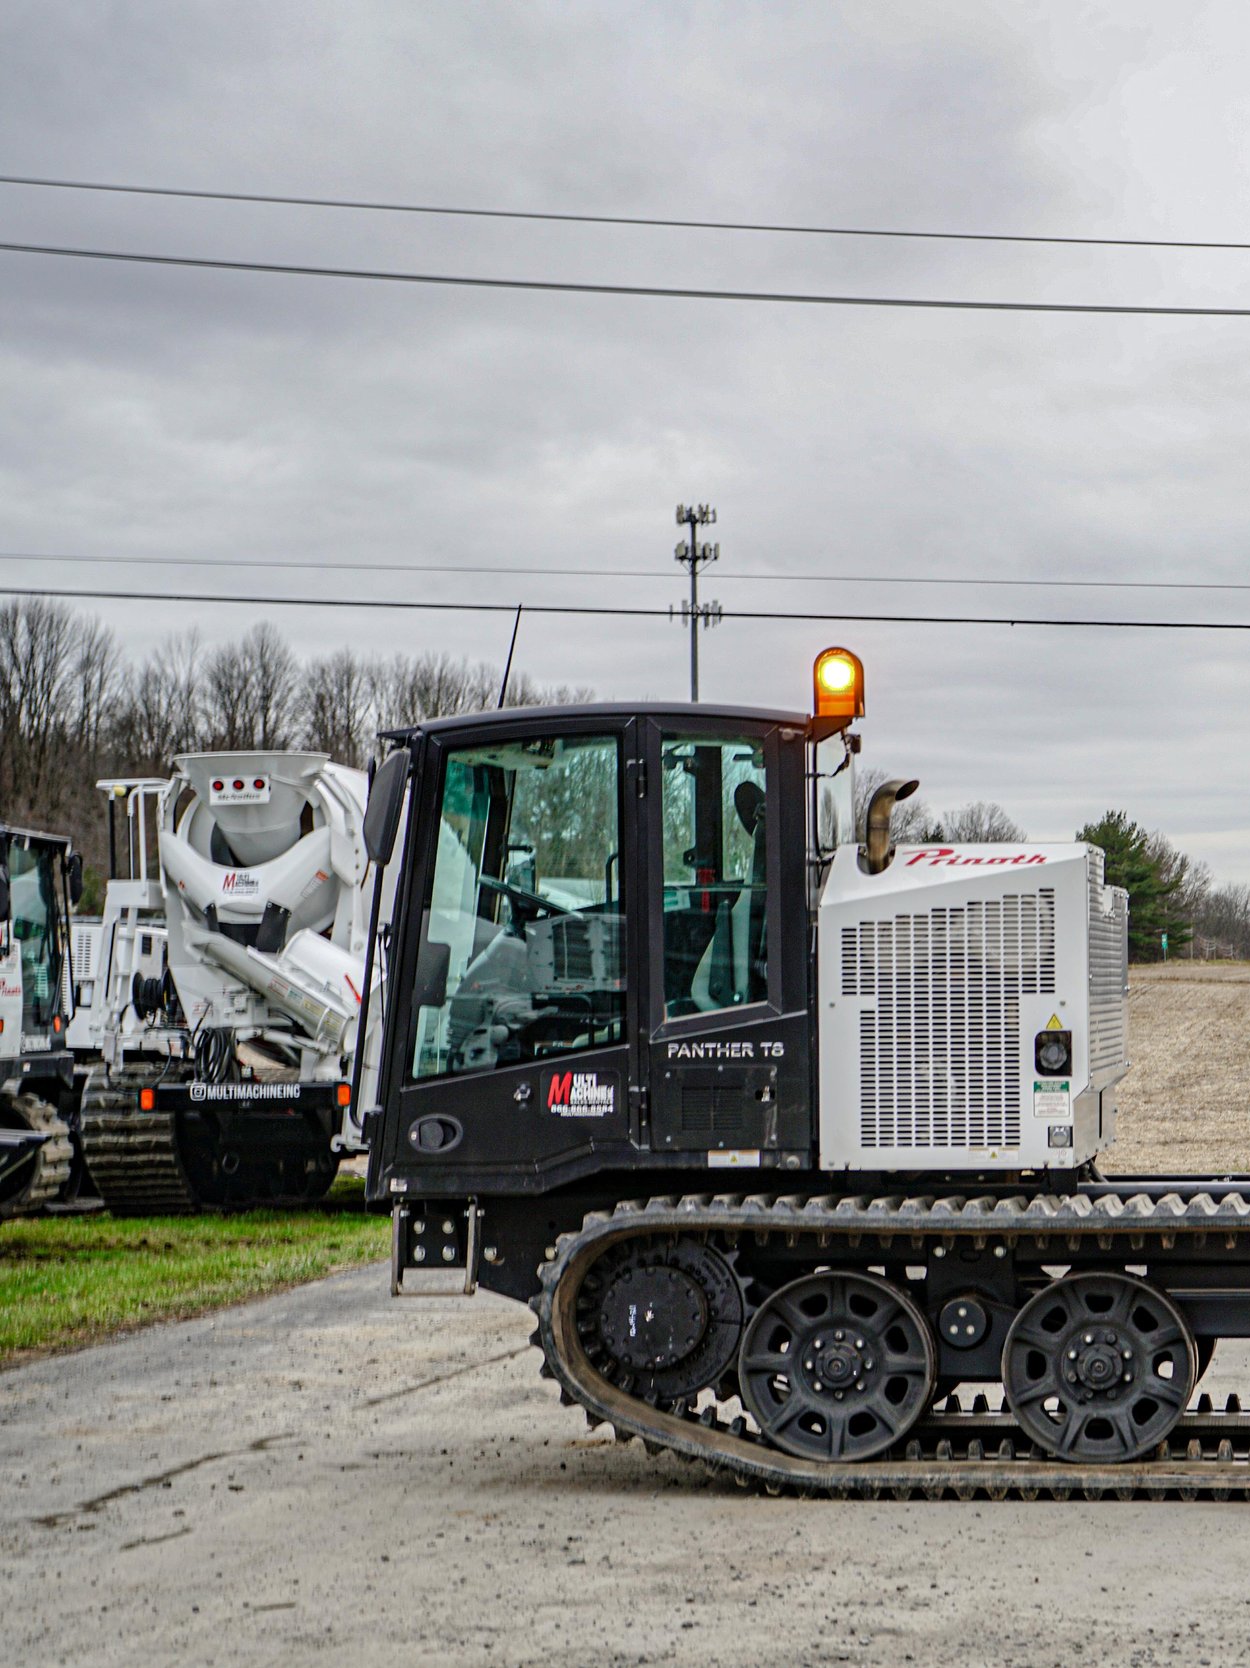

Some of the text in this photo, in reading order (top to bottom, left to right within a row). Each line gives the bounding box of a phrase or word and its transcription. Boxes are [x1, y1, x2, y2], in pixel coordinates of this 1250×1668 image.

[902, 848, 1048, 866] Prinoth
[667, 1041, 784, 1058] PANTHER T8
